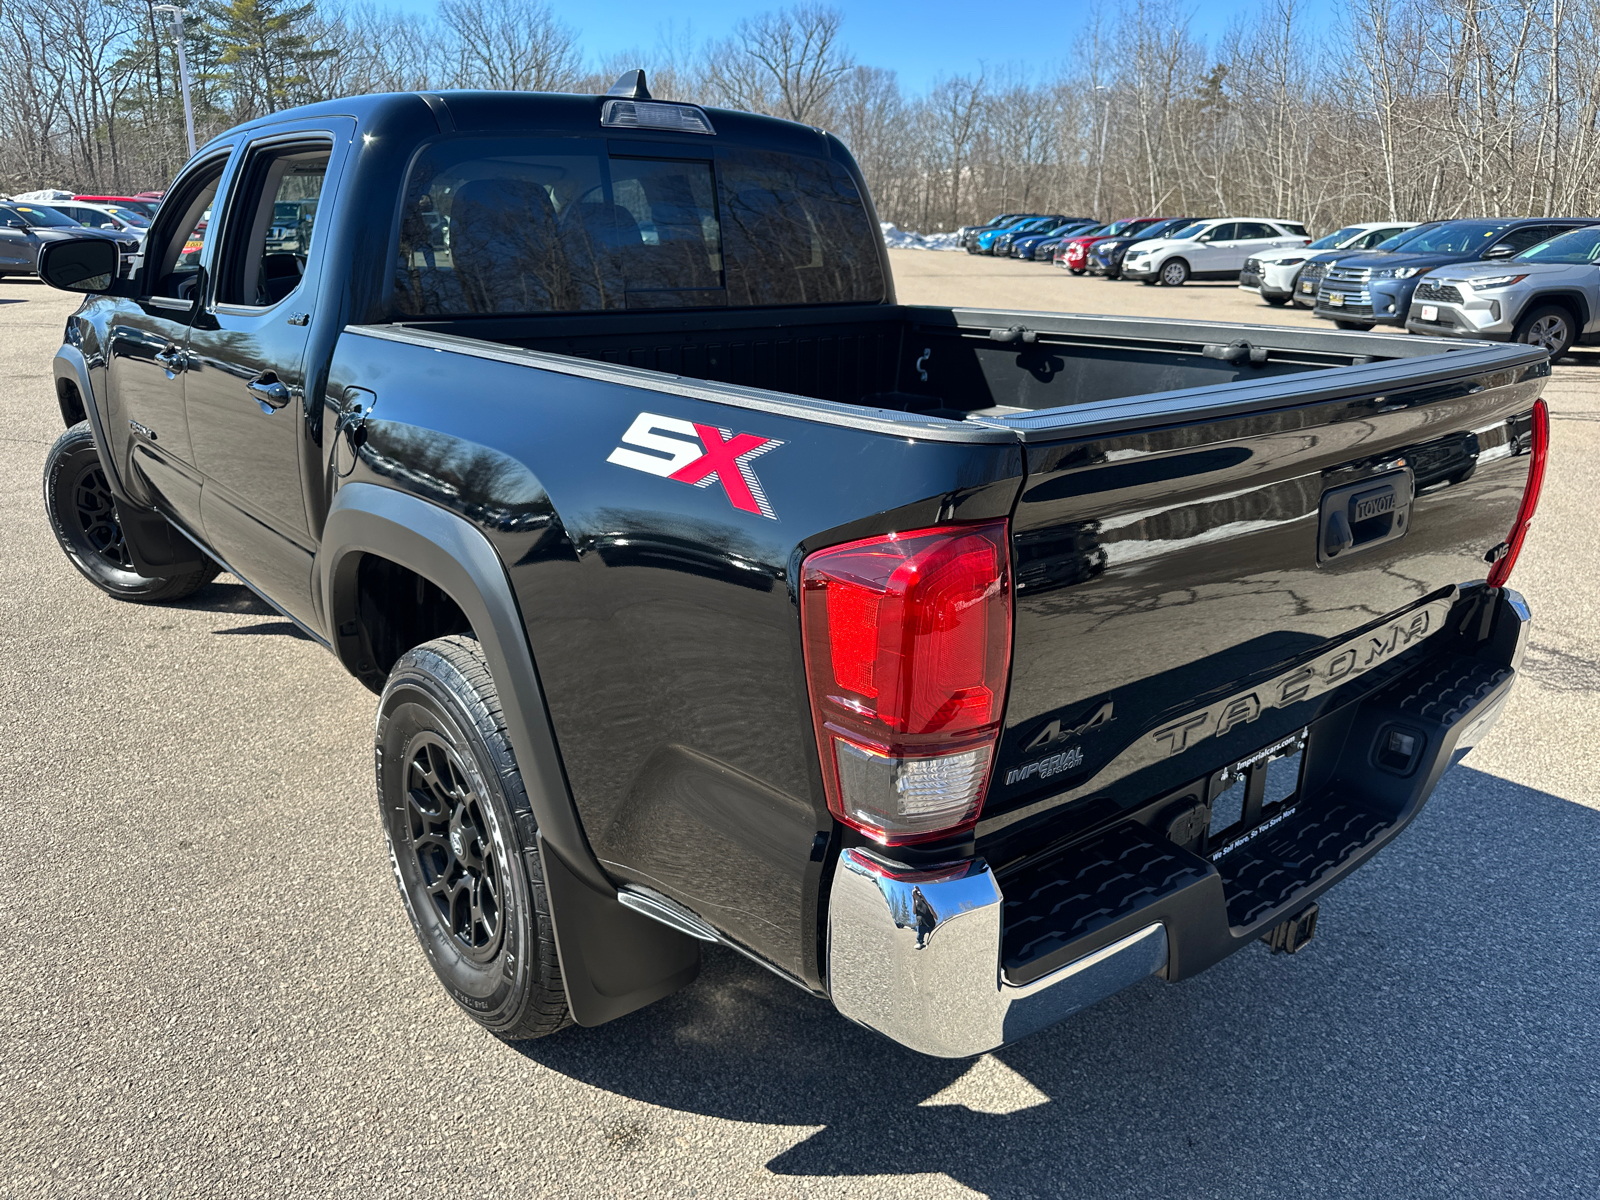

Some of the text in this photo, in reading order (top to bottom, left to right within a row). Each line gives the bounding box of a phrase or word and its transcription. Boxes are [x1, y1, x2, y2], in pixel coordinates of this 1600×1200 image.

[1357, 493, 1396, 518] TOYOTA
[1152, 609, 1430, 756] TACOMA
[1005, 746, 1084, 786] IMPERIAL
[1040, 758, 1083, 779] cars.com
[1236, 736, 1296, 770] Imperialcars.com
[1212, 851, 1223, 861] We
[1223, 843, 1234, 855] Sell
[1250, 830, 1258, 839] So
[1259, 823, 1270, 833] You
[1269, 815, 1283, 827] Save
[1282, 807, 1296, 819] More
